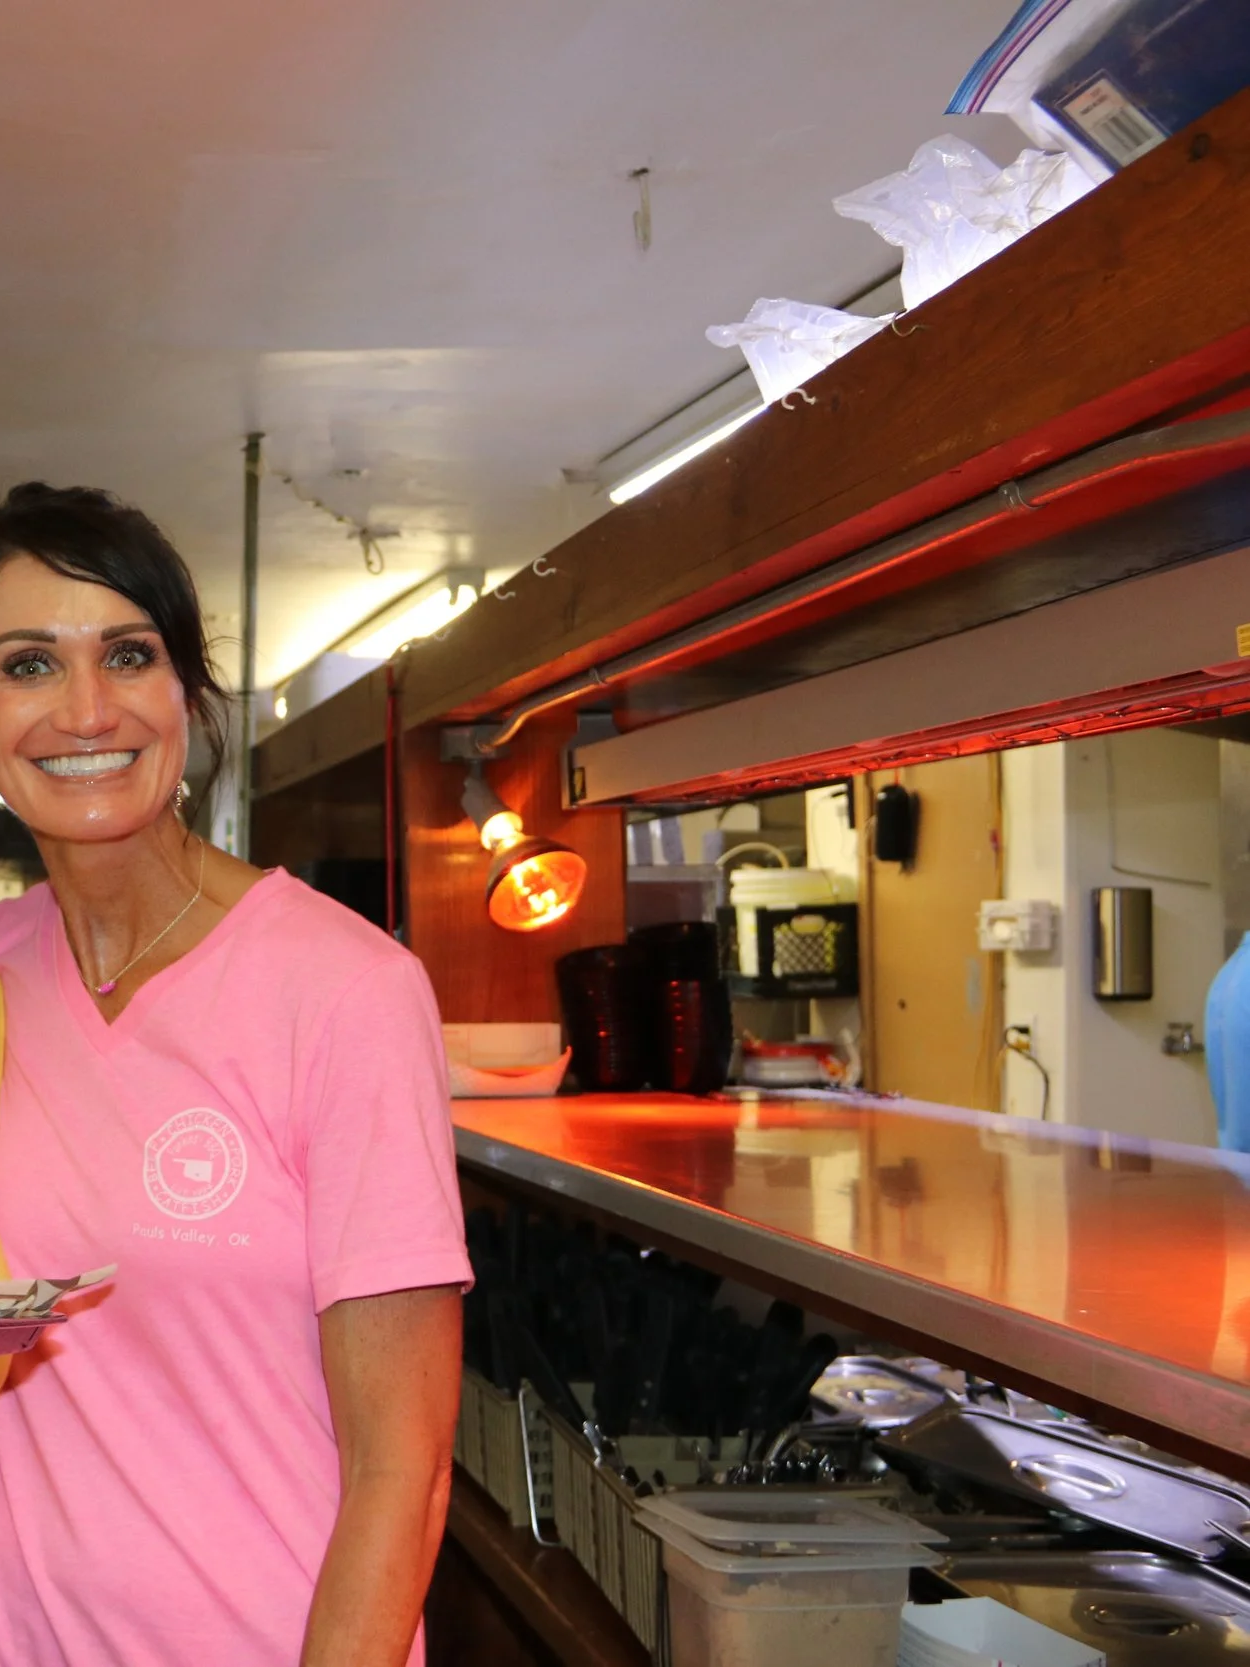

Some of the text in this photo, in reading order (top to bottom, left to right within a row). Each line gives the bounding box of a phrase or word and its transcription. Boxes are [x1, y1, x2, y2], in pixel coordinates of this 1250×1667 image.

[166, 1113, 233, 1138] CHICKEN
[229, 1147, 243, 1189] PORK
[155, 1189, 225, 1215] CATFISH
[132, 1222, 165, 1240] Pauls
[228, 1232, 250, 1246] OK
